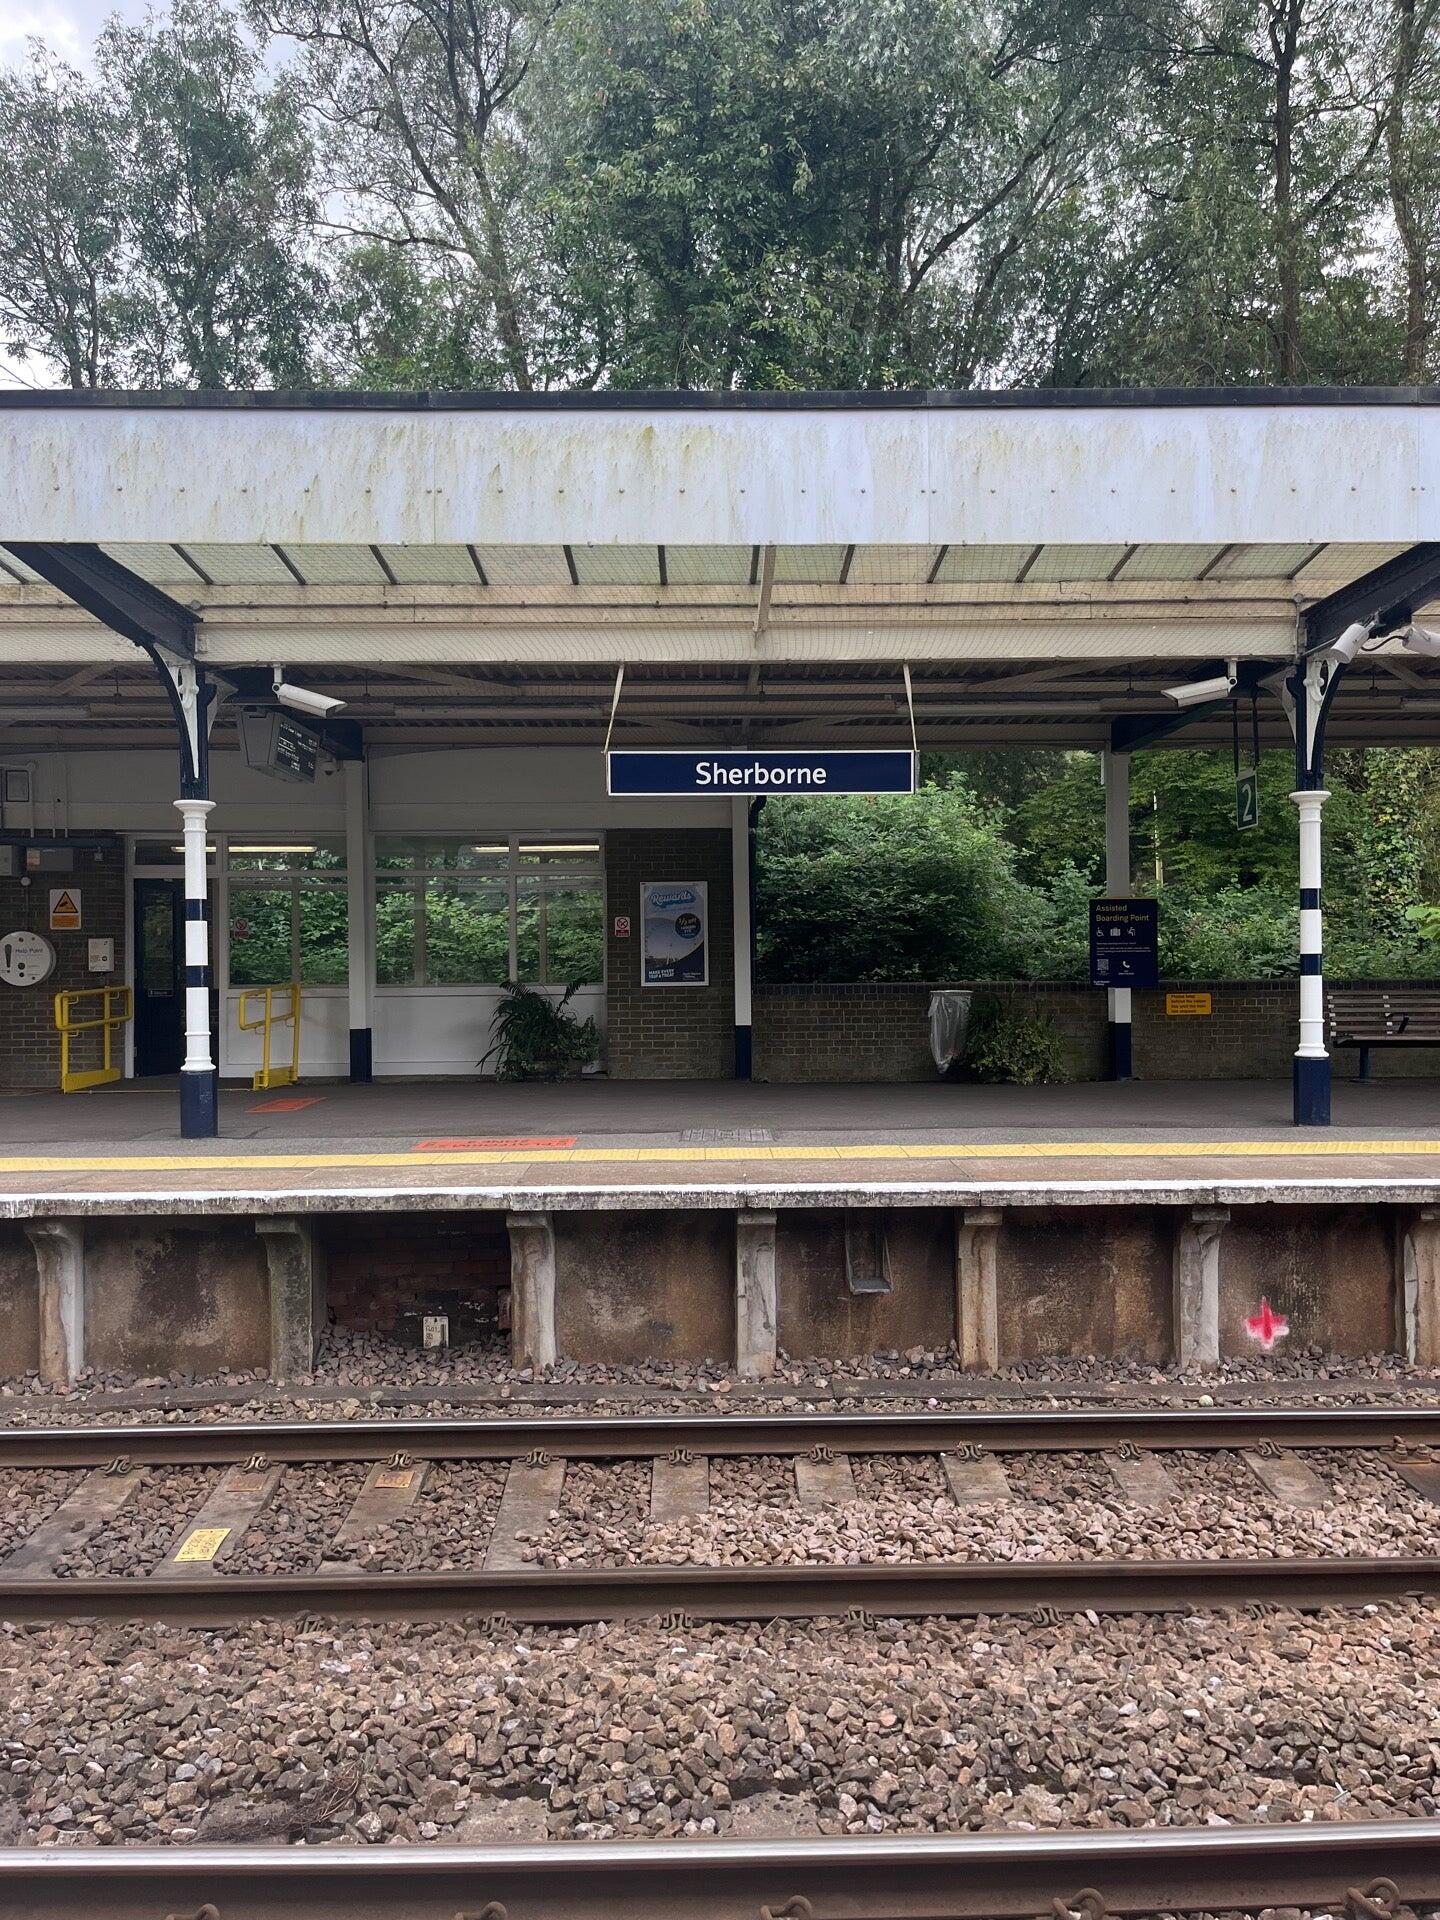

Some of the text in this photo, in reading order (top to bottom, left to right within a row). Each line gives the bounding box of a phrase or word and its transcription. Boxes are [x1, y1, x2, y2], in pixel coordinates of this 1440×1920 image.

[695, 761, 827, 785] Sherborne
[1242, 783, 1252, 821] 2
[651, 890, 692, 906] Rewards
[1096, 904, 1127, 912] Assisted
[1096, 914, 1149, 923] Boarding Point
